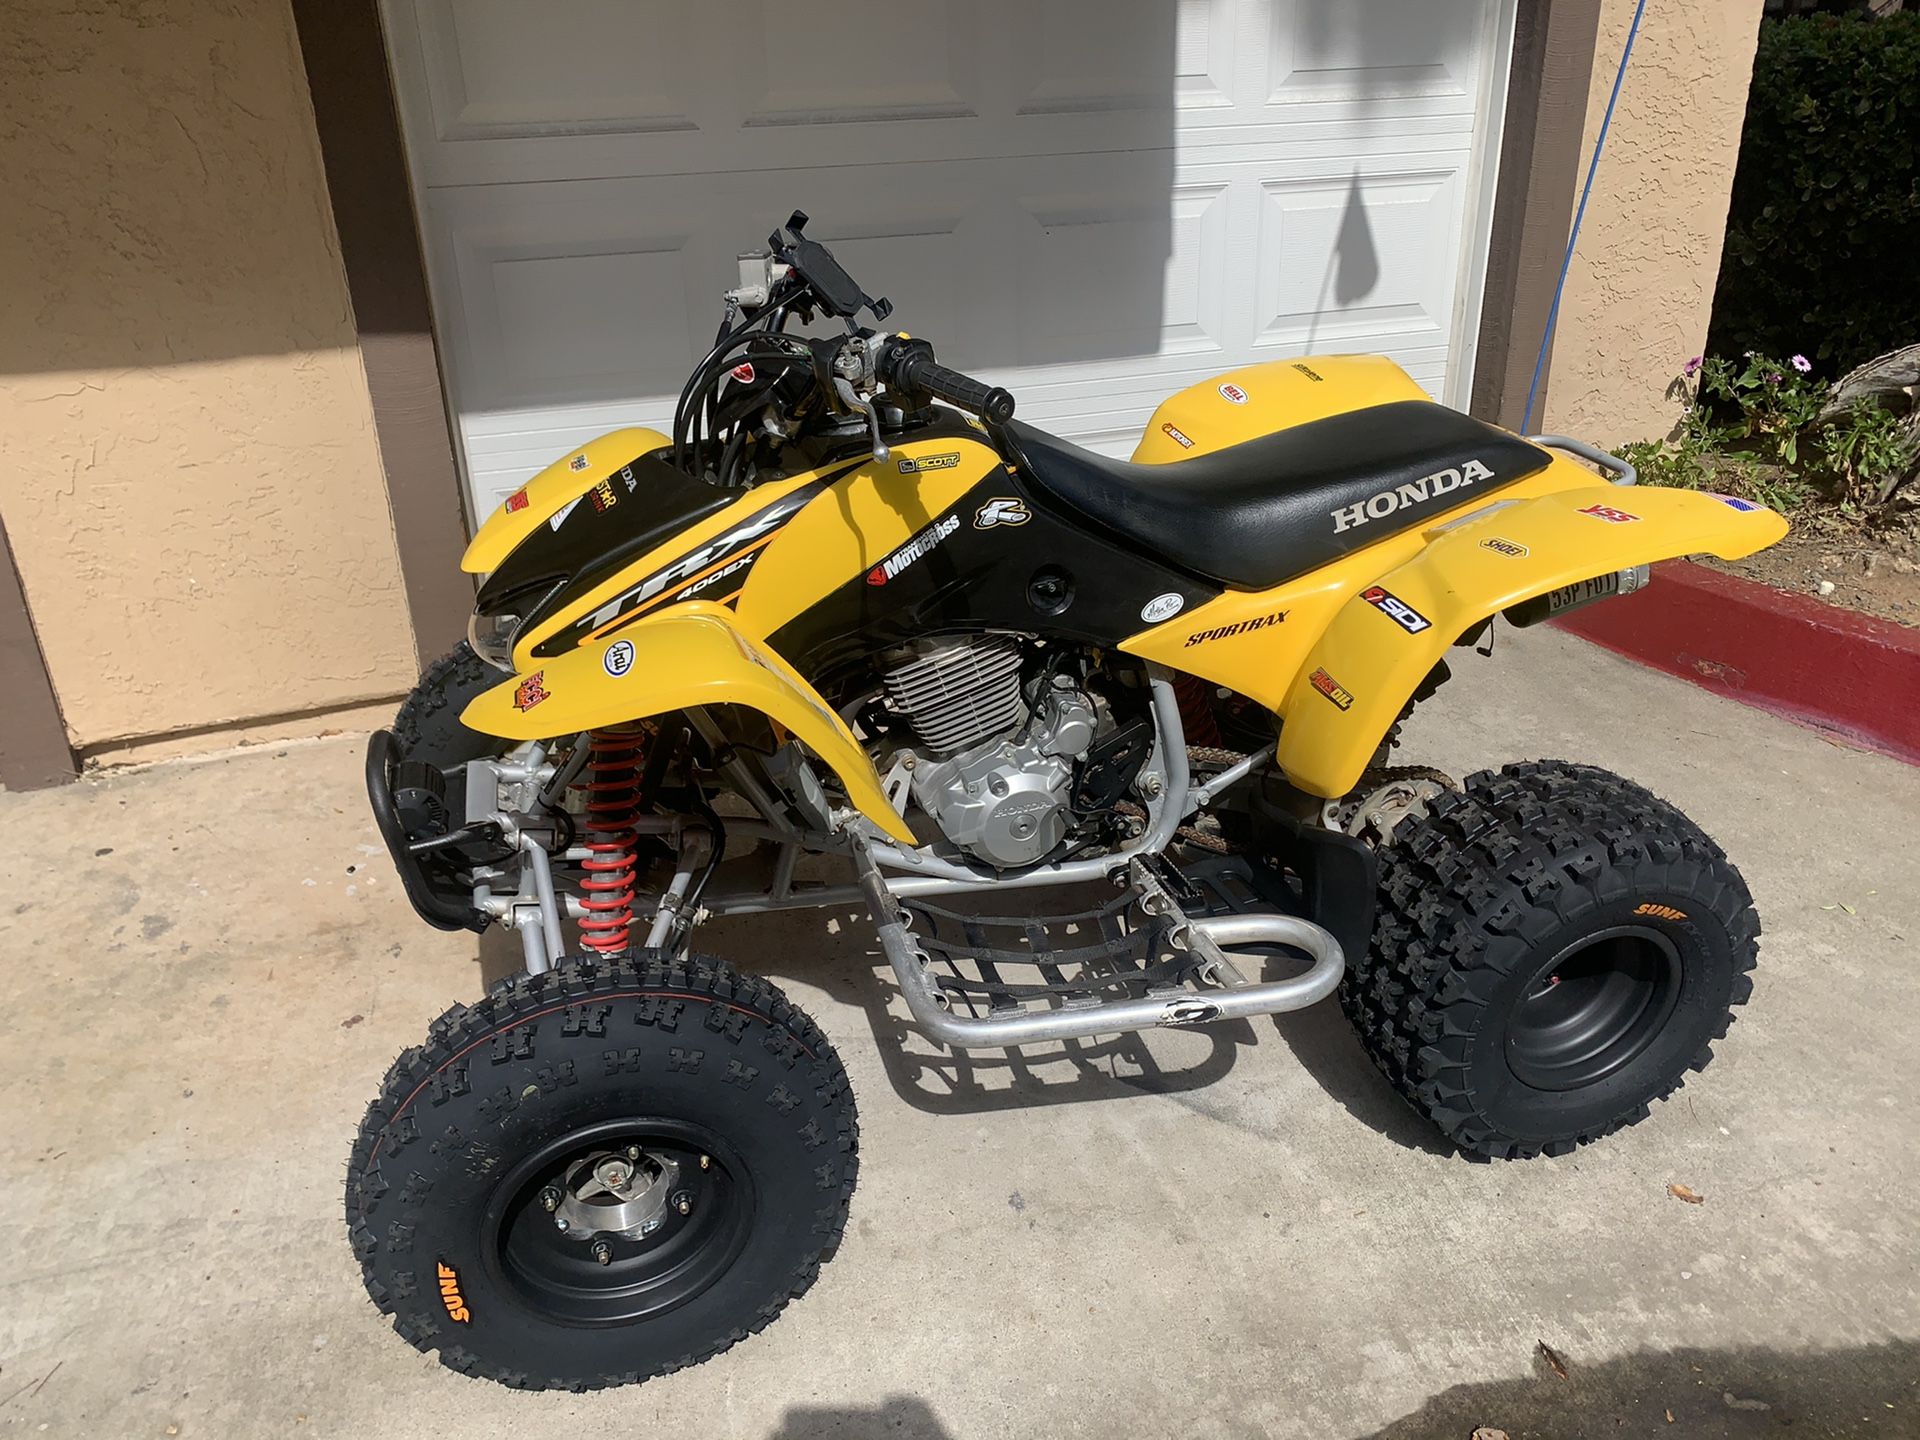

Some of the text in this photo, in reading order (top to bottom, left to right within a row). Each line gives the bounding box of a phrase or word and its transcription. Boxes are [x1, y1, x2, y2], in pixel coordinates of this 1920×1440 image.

[1224, 385, 1243, 401] BELL
[917, 455, 957, 468] SCOTT
[1331, 459, 1495, 534] HONDA
[1484, 538, 1523, 557] SHOEI
[676, 553, 754, 601] 400EX
[1184, 609, 1290, 648] SPORTRAX
[611, 645, 630, 671] Arai
[1310, 670, 1352, 708] AMSOIL
[1633, 903, 1688, 920] SUNF
[438, 1261, 470, 1323] SUNF
